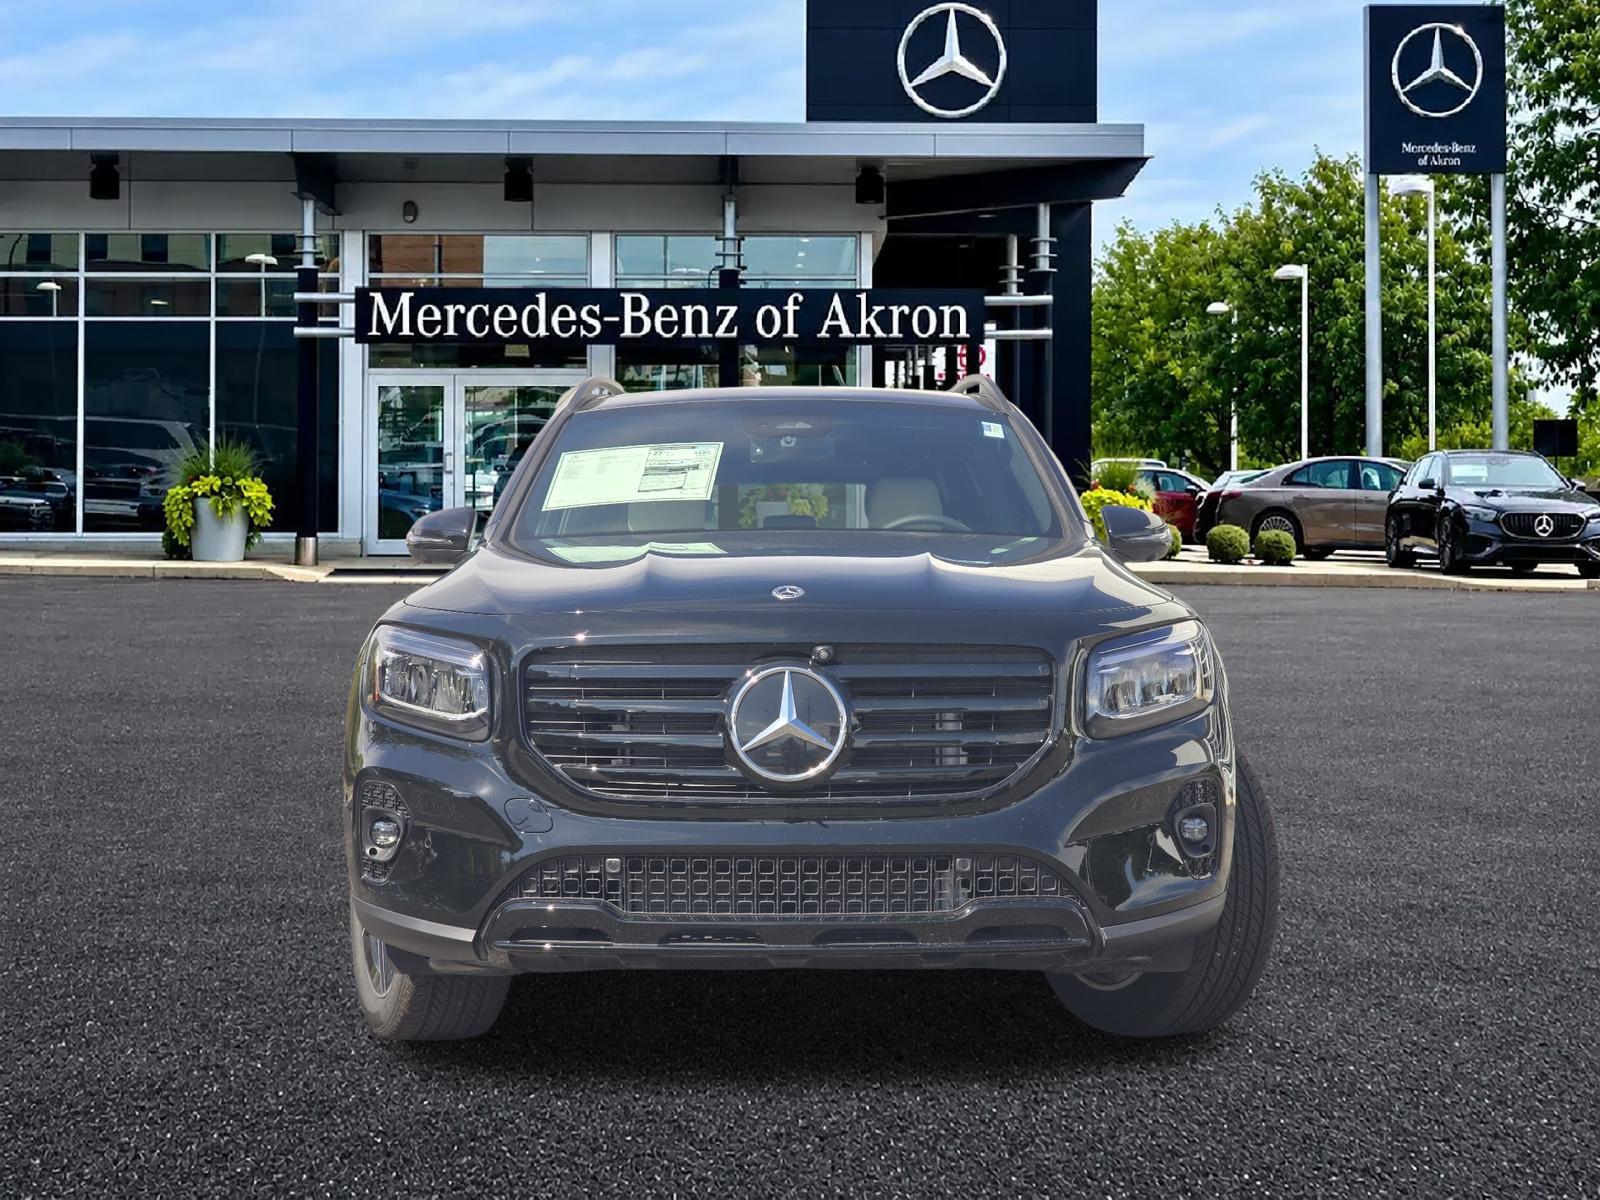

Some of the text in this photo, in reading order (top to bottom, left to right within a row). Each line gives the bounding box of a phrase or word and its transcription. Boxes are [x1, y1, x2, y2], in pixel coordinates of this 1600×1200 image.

[1401, 141, 1476, 154] Mercedes-Benz
[1417, 154, 1461, 166] of Akron
[367, 292, 970, 338] Mercedes-Benz of Akron
